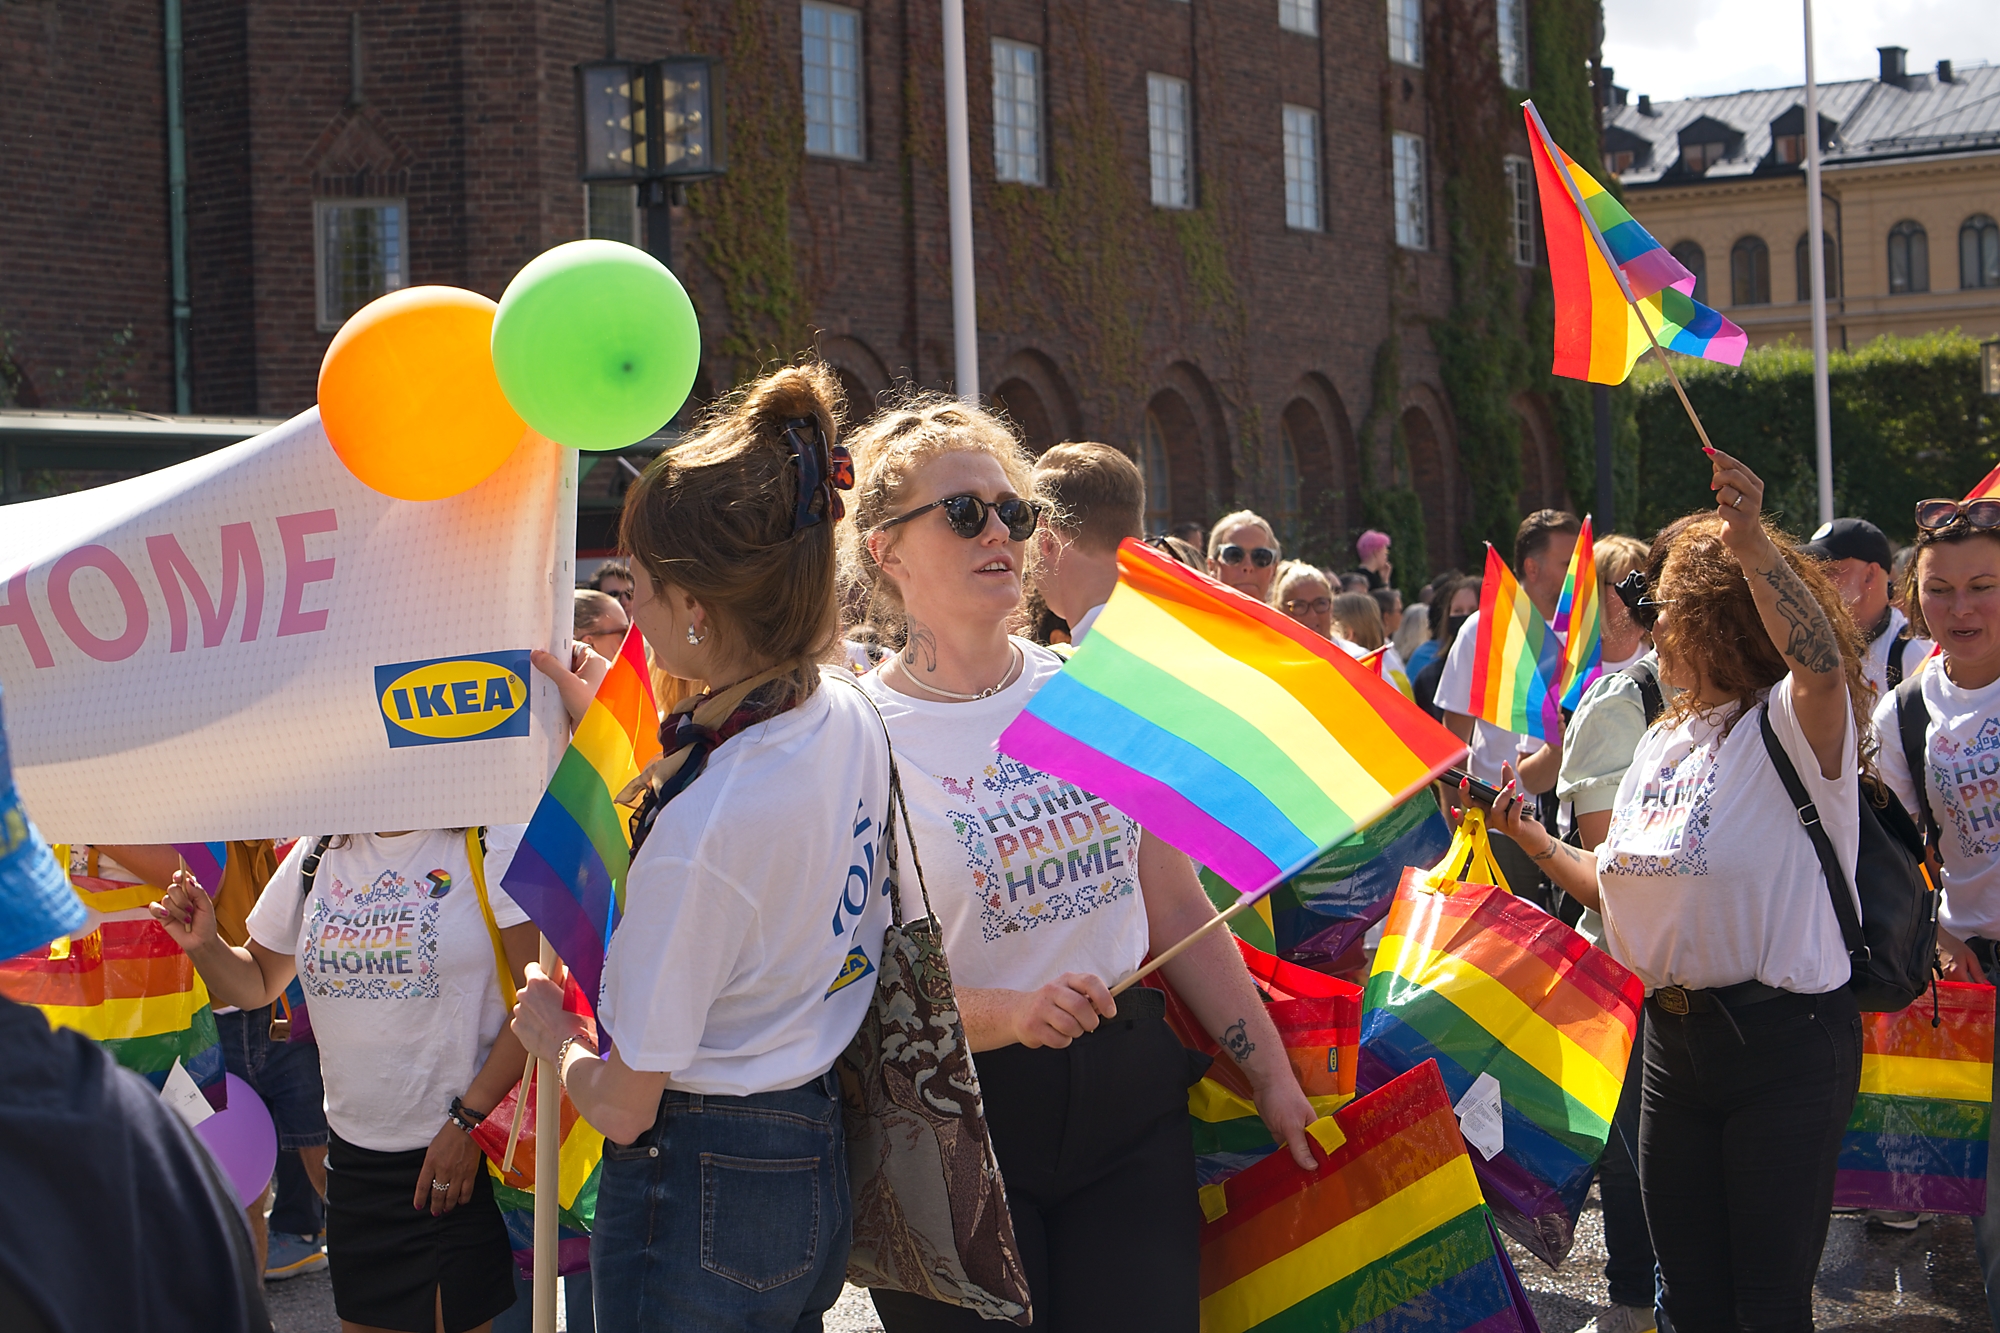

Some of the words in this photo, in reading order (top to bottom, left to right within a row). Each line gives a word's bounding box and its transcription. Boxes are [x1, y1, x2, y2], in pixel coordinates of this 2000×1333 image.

[392, 677, 515, 720] IKEA
[977, 779, 1100, 833] HOM
[994, 802, 1119, 868] PRIDE
[1005, 835, 1124, 903] HOME
[328, 902, 419, 927] HOME
[320, 924, 413, 949] PRIDE
[319, 950, 413, 974] HOME
